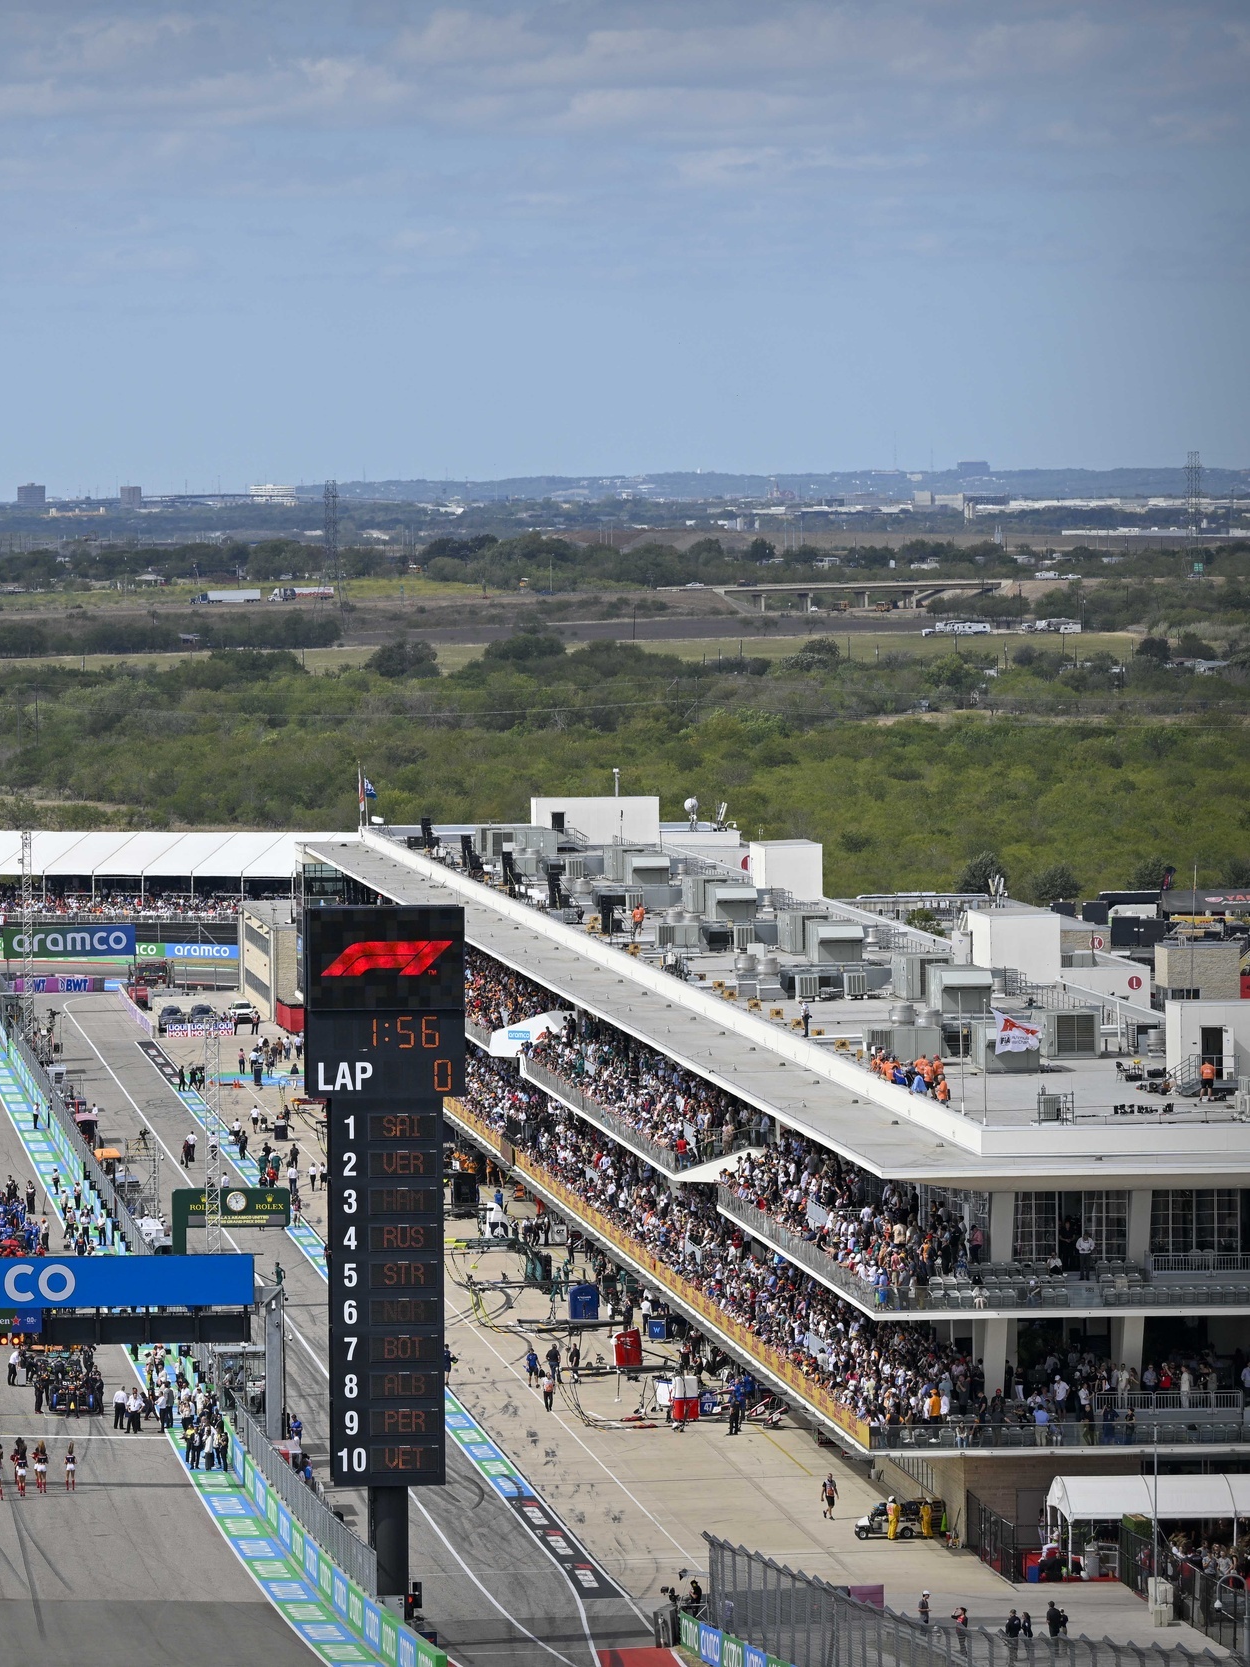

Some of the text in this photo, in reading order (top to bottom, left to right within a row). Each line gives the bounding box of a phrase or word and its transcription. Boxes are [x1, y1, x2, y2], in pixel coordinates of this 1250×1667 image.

[12, 931, 127, 952] aramco
[174, 945, 230, 957] aramco
[1094, 938, 1100, 948] K
[65, 978, 89, 992] BWT
[1132, 978, 1138, 988] L
[372, 1016, 439, 1048] 1:56
[317, 1059, 452, 1092] LAP 0
[343, 1115, 421, 1140] 1 SAI
[342, 1152, 424, 1177] 2 VER
[343, 1189, 357, 1214] 3
[343, 1226, 424, 1250] 4 RUS
[343, 1263, 425, 1288] 5 STR
[343, 1299, 358, 1325] 6
[343, 1337, 424, 1361] 7 BOT
[344, 1373, 425, 1399] 8 ALB
[344, 1410, 359, 1436] 9
[384, 1411, 426, 1433] PER
[337, 1447, 424, 1472] 10 VET
